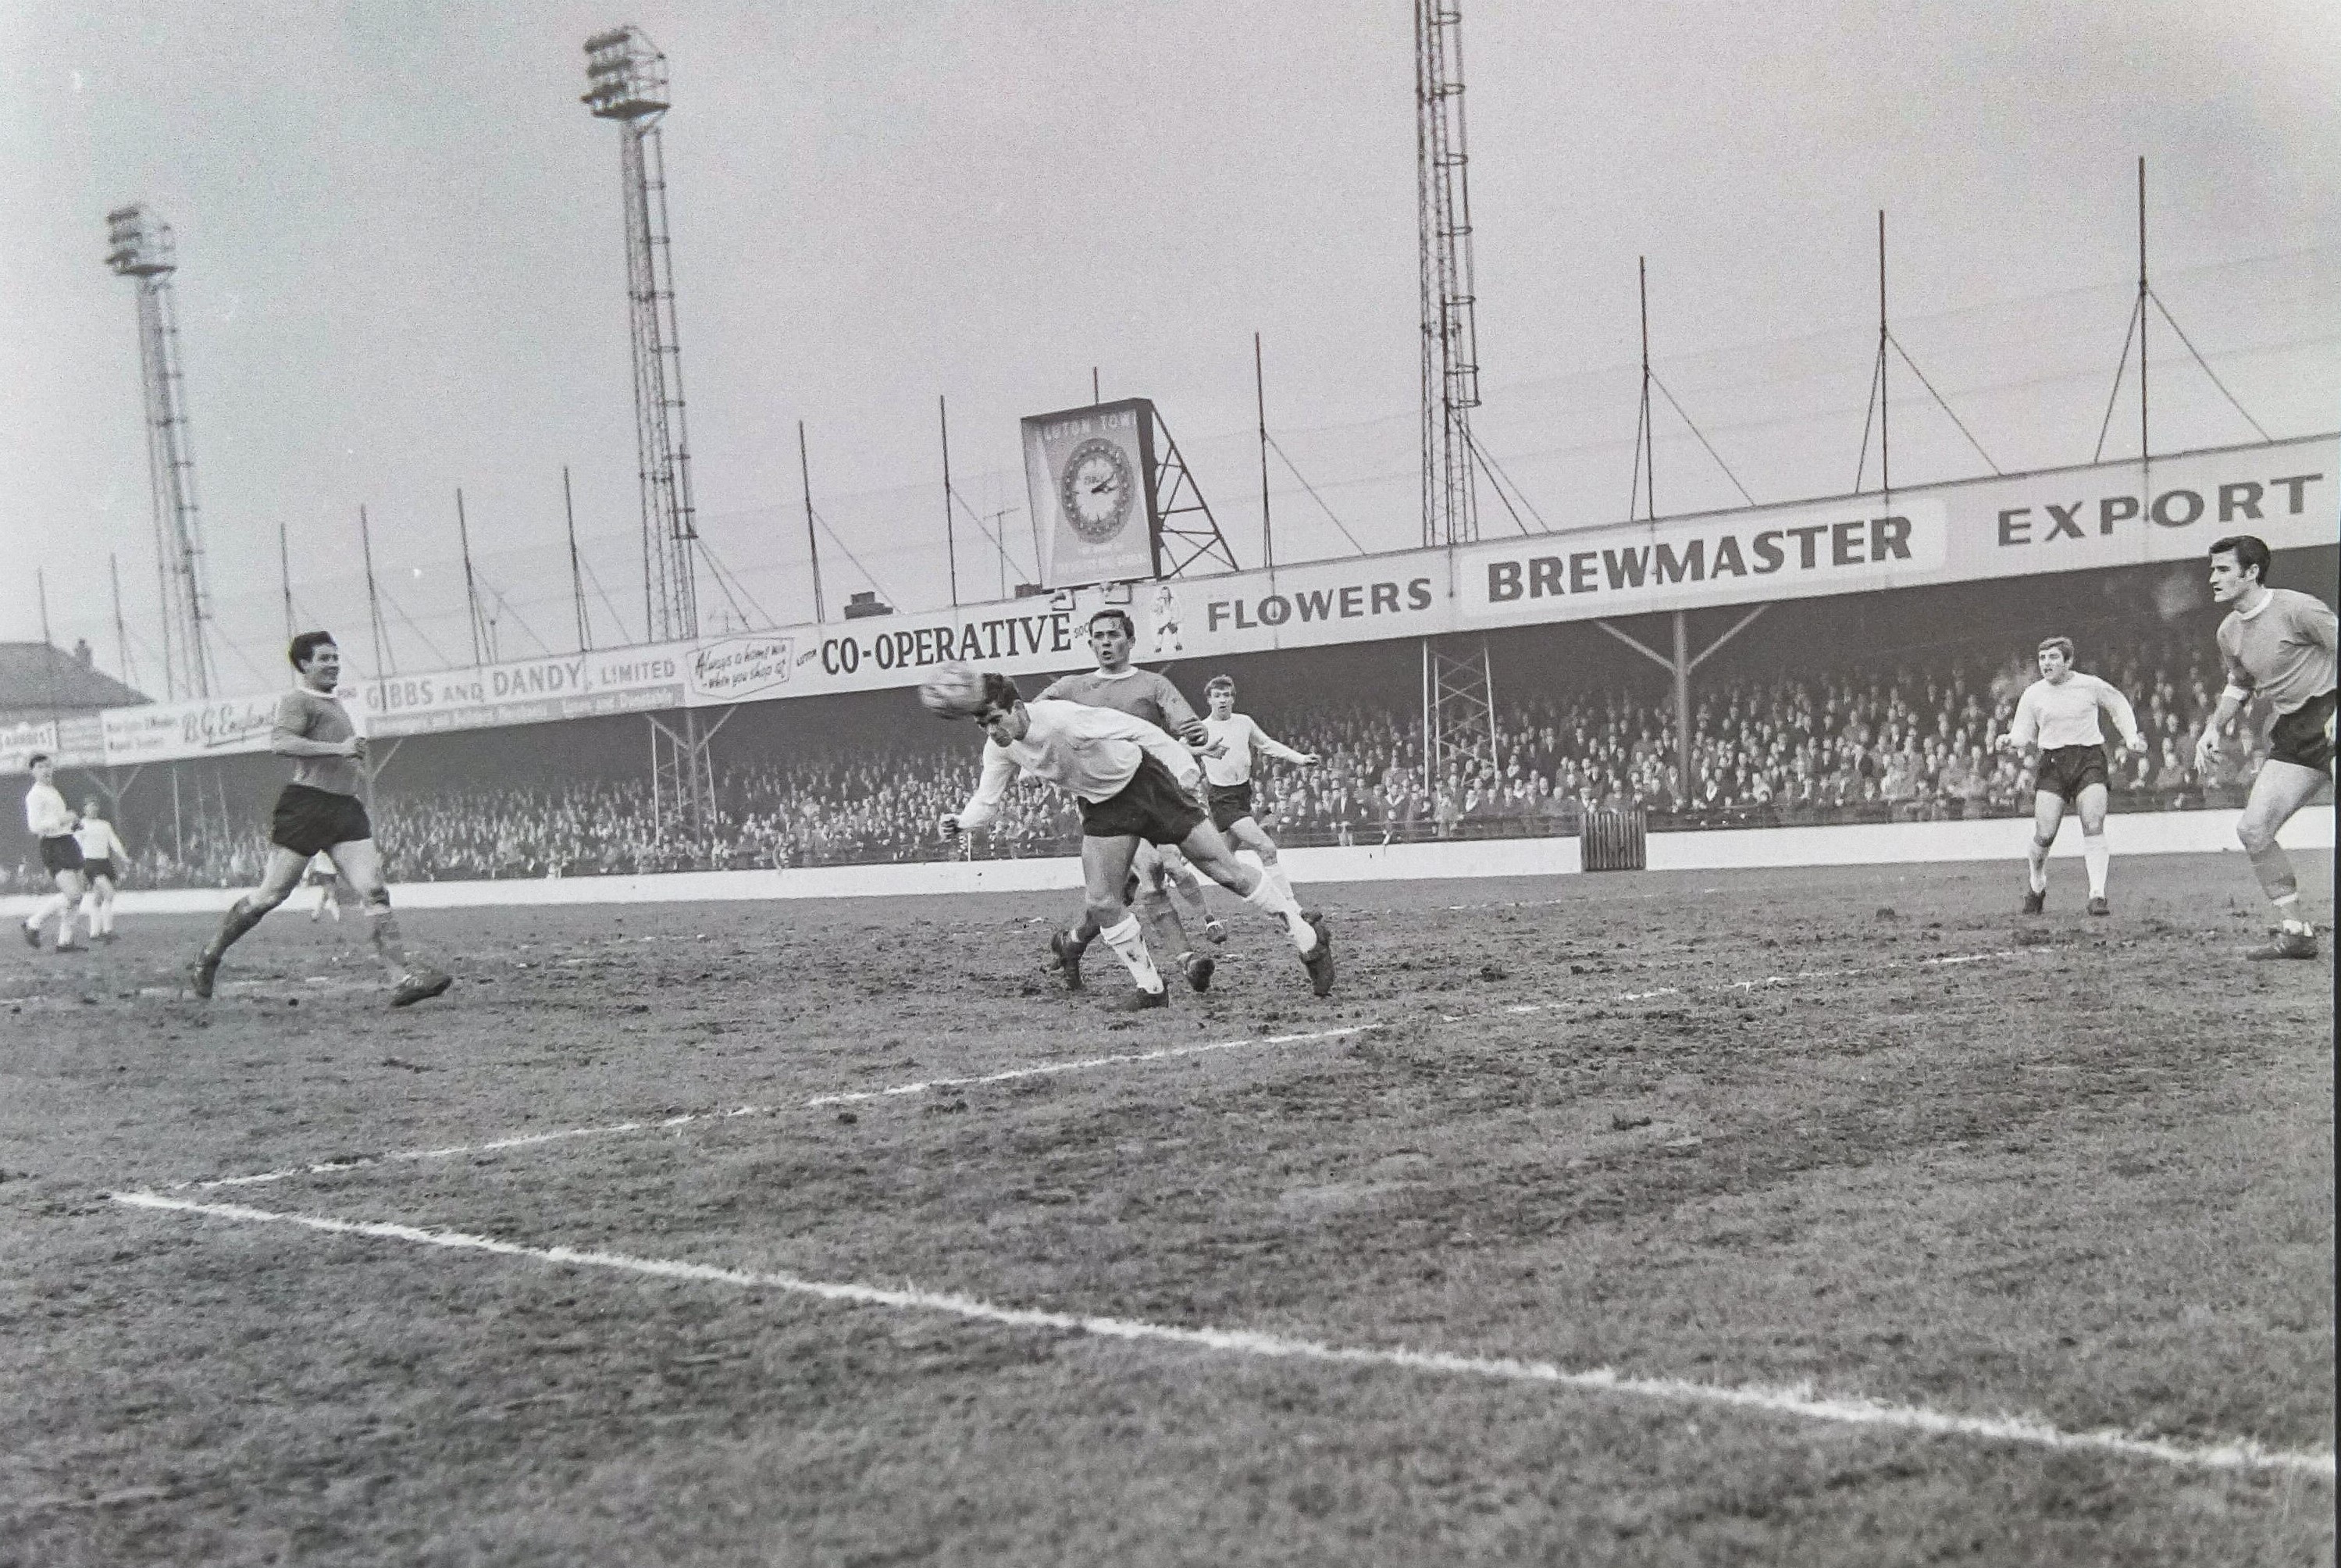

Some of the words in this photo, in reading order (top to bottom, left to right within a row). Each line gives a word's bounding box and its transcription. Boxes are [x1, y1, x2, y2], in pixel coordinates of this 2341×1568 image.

[1207, 577, 1432, 632] FLOWERS
[1488, 515, 1913, 603] BREWMASTER
[1997, 472, 2324, 547] EXPORT
[821, 612, 1072, 675] CO-OPERATIVE
[365, 680, 434, 711] GIBBS
[443, 682, 484, 702] AND
[601, 658, 675, 685] LIMITED
